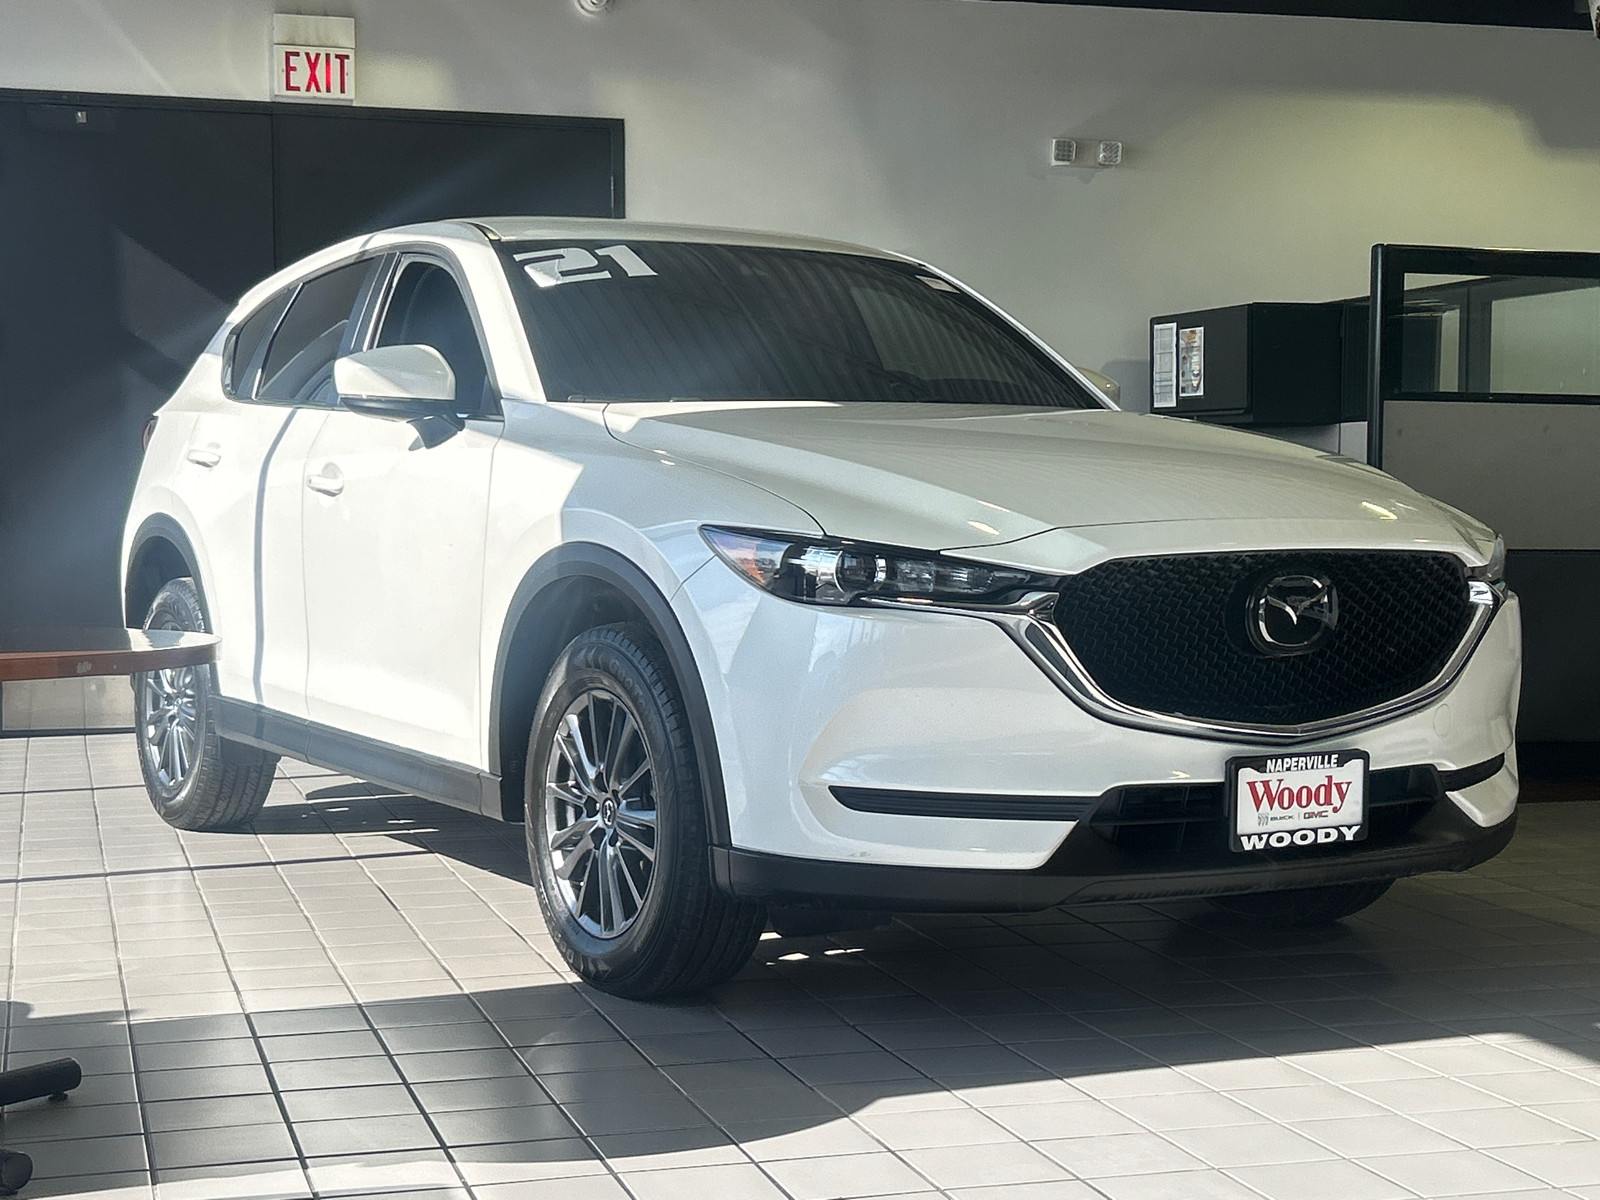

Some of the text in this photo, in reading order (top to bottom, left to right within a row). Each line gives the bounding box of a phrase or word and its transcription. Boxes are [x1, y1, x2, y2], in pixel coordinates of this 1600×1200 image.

[284, 51, 350, 94] EXIT
[513, 244, 659, 288] 21
[1266, 754, 1339, 773] NAPERVILLE
[1246, 775, 1352, 813] Woody
[1303, 810, 1329, 819] GMC
[1240, 825, 1361, 850] WOODY
